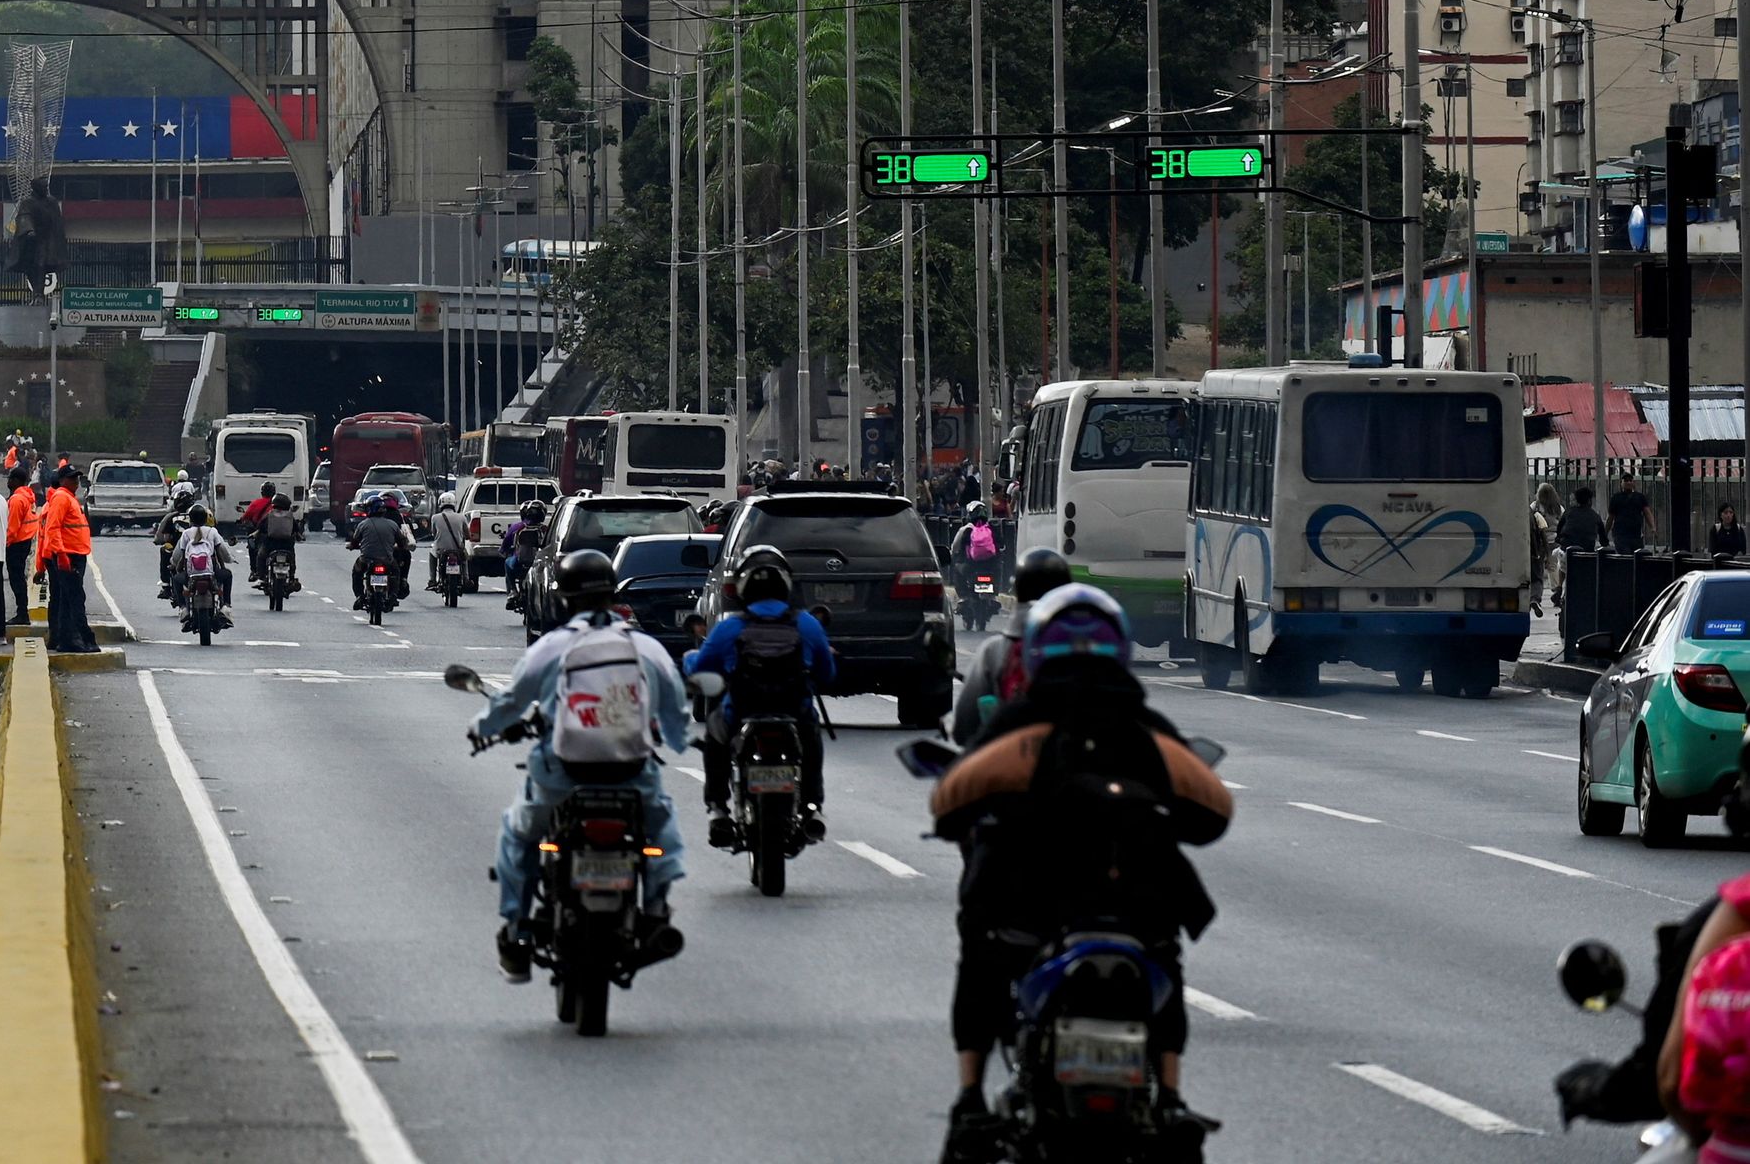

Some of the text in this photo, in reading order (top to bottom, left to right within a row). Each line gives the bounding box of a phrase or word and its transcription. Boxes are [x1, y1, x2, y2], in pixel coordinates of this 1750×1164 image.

[876, 155, 911, 184] 38
[1151, 150, 1185, 179] 38
[322, 299, 363, 307] TERMINAL
[383, 299, 400, 307] TUY
[84, 314, 119, 322] ALTURA
[120, 312, 157, 323] MÁXIMA
[175, 307, 189, 319] 38
[259, 308, 272, 321] 38
[337, 317, 373, 326] ALTURA
[375, 316, 411, 326] MÁXIMA
